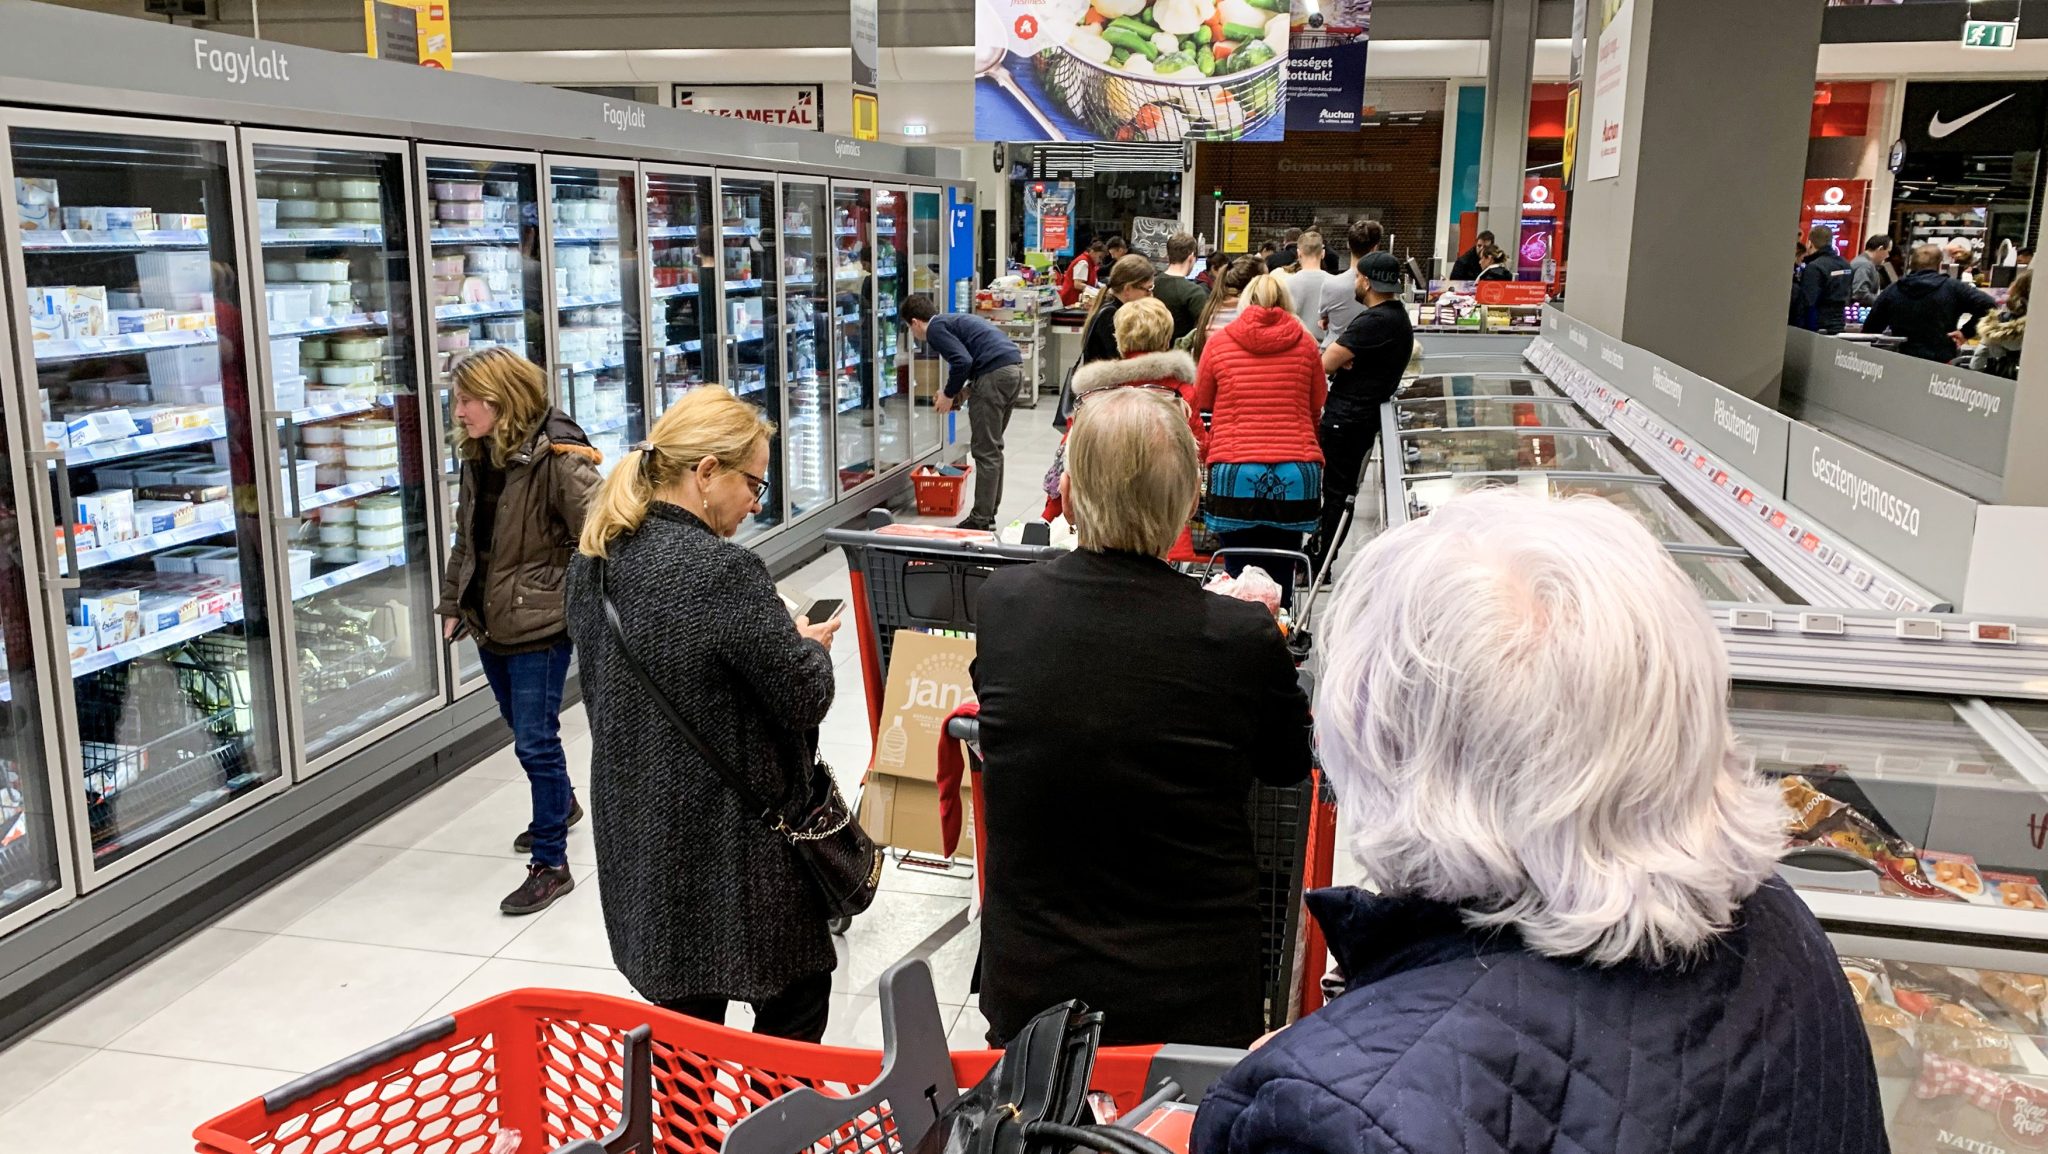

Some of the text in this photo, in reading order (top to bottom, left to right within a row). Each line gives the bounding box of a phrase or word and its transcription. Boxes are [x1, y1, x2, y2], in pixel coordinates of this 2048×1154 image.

[194, 38, 290, 84] Fagylalt
[603, 102, 646, 132] Fagylalt
[1320, 108, 1355, 119] Auchan
[835, 139, 861, 159] Gyümölcs
[1653, 365, 1683, 407] Péksütemény
[1834, 349, 1884, 383] Hasábburgonya
[1928, 373, 2001, 417] Hasábburgonya
[1713, 397, 1760, 454] Péksütemény
[1811, 446, 1920, 537] Gesztenyemassza
